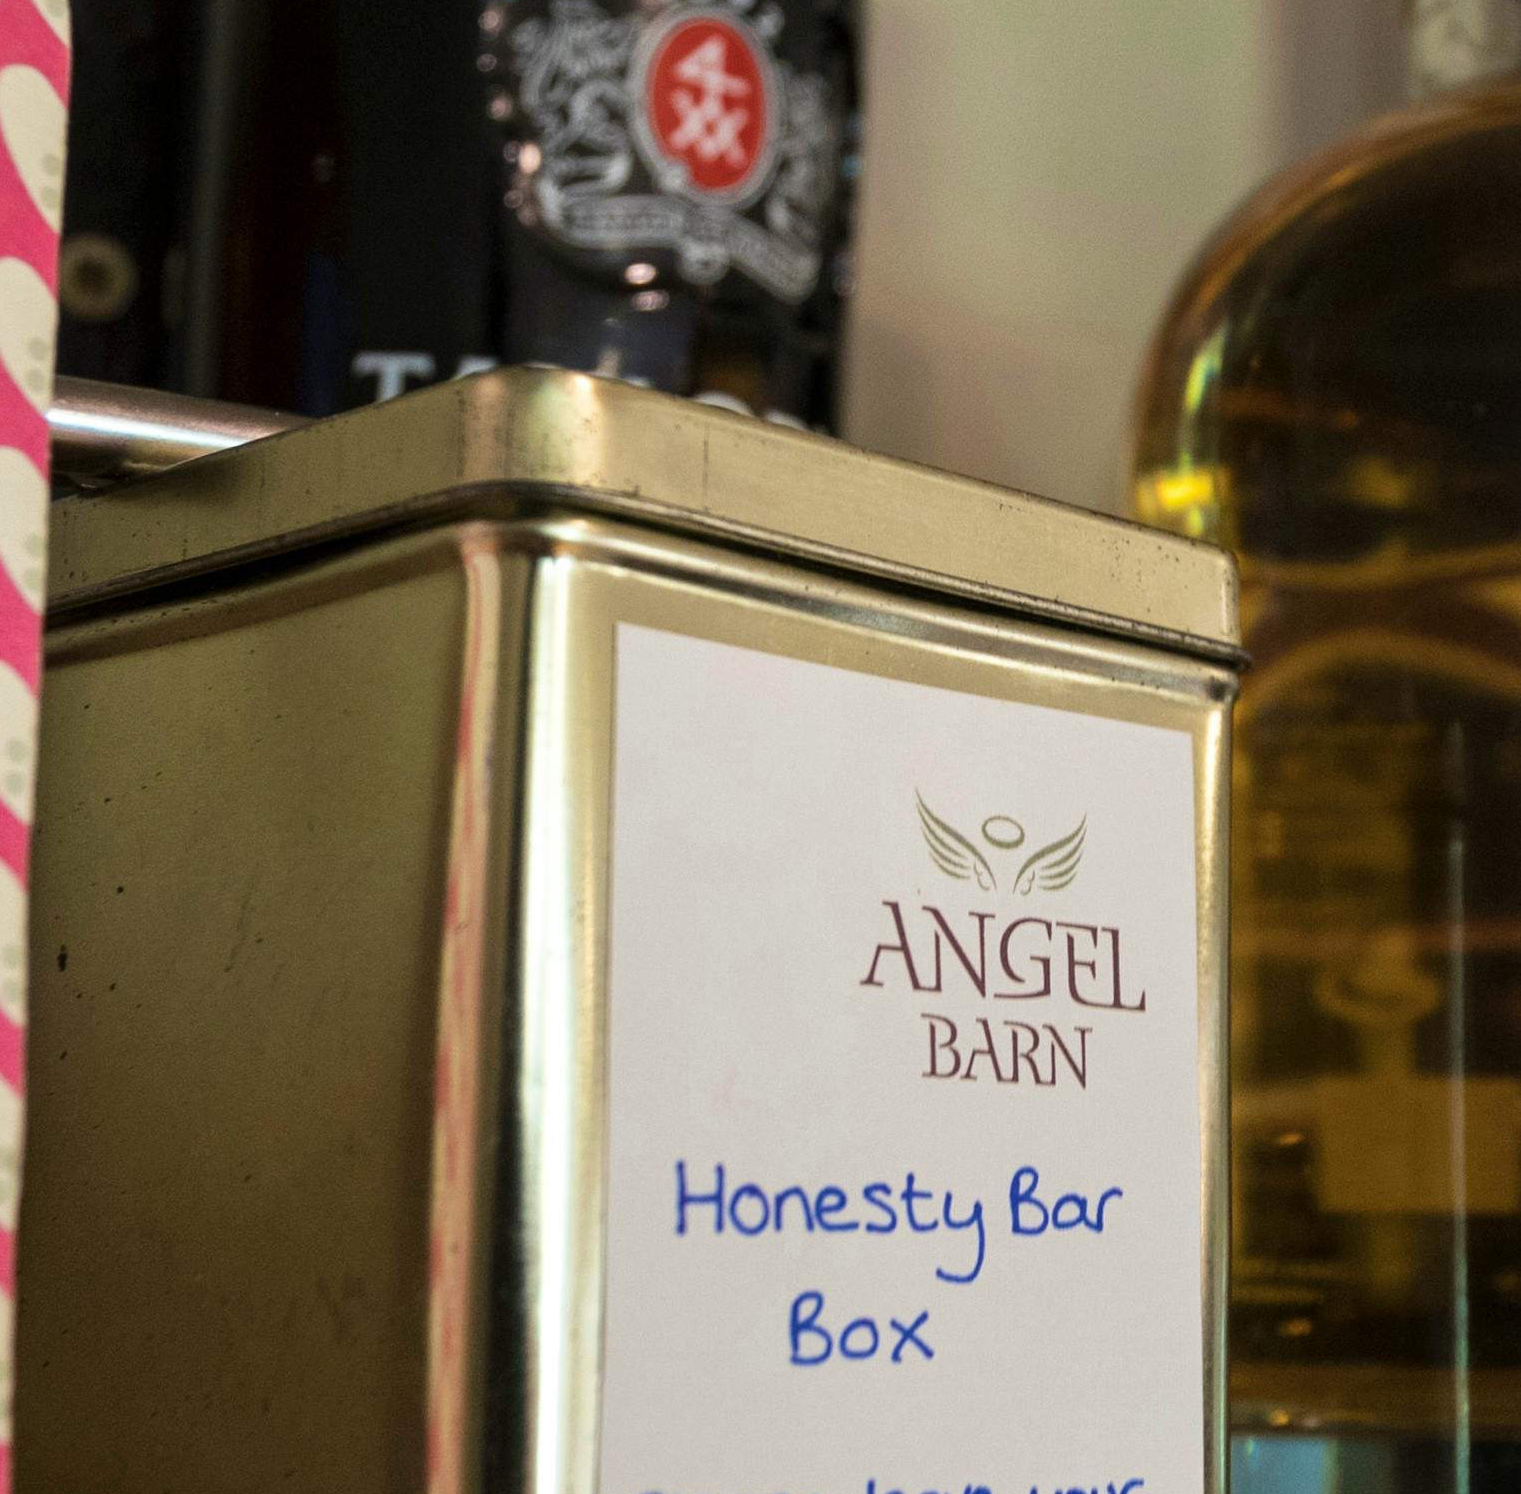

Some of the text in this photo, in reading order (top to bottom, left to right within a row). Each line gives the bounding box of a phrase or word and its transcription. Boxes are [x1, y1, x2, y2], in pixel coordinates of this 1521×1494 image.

[858, 899, 1148, 1013] ANGEL
[920, 1013, 1095, 1090] BARN
[673, 1159, 1125, 1285] Honesty Bar
[786, 1289, 935, 1367] Box
